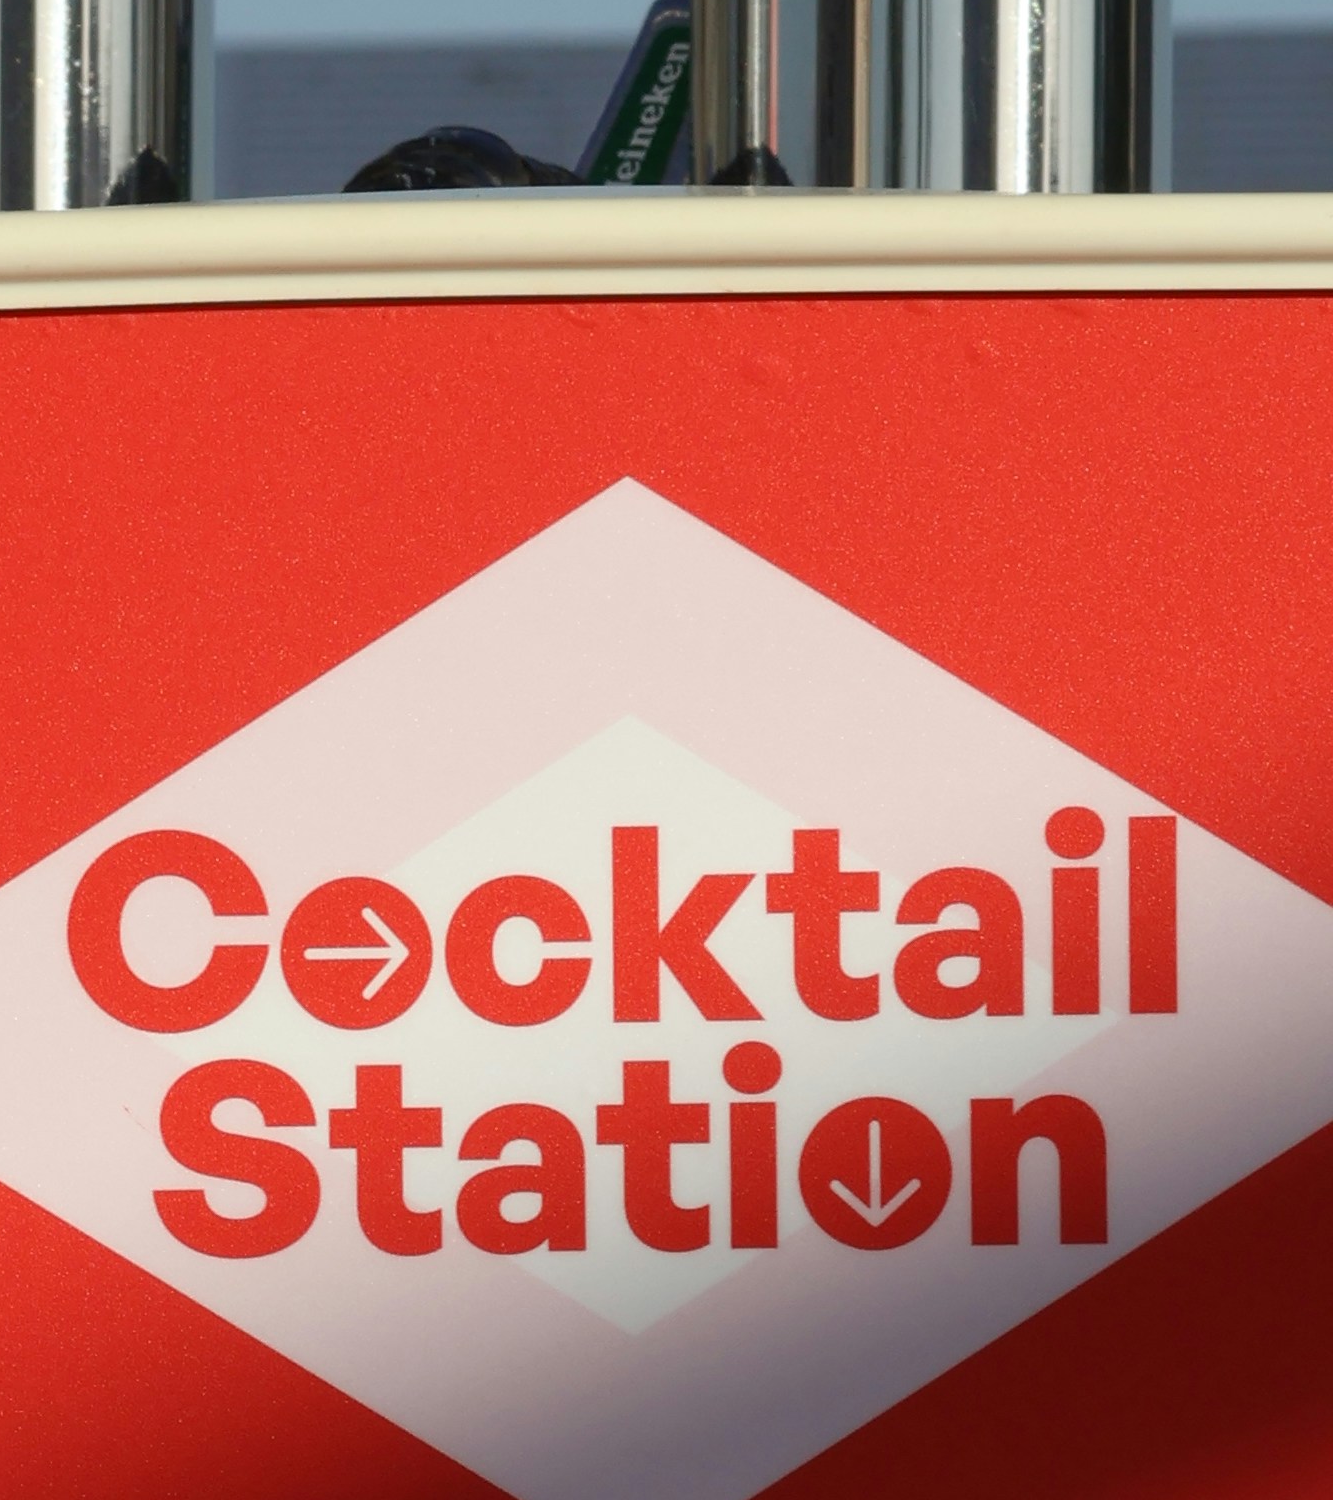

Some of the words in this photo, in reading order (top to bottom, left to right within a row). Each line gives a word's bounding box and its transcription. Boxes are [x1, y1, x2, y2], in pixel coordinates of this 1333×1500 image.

[604, 42, 690, 186] eineken
[66, 806, 1178, 1034] Cocktail
[151, 1041, 1109, 1260] Station
